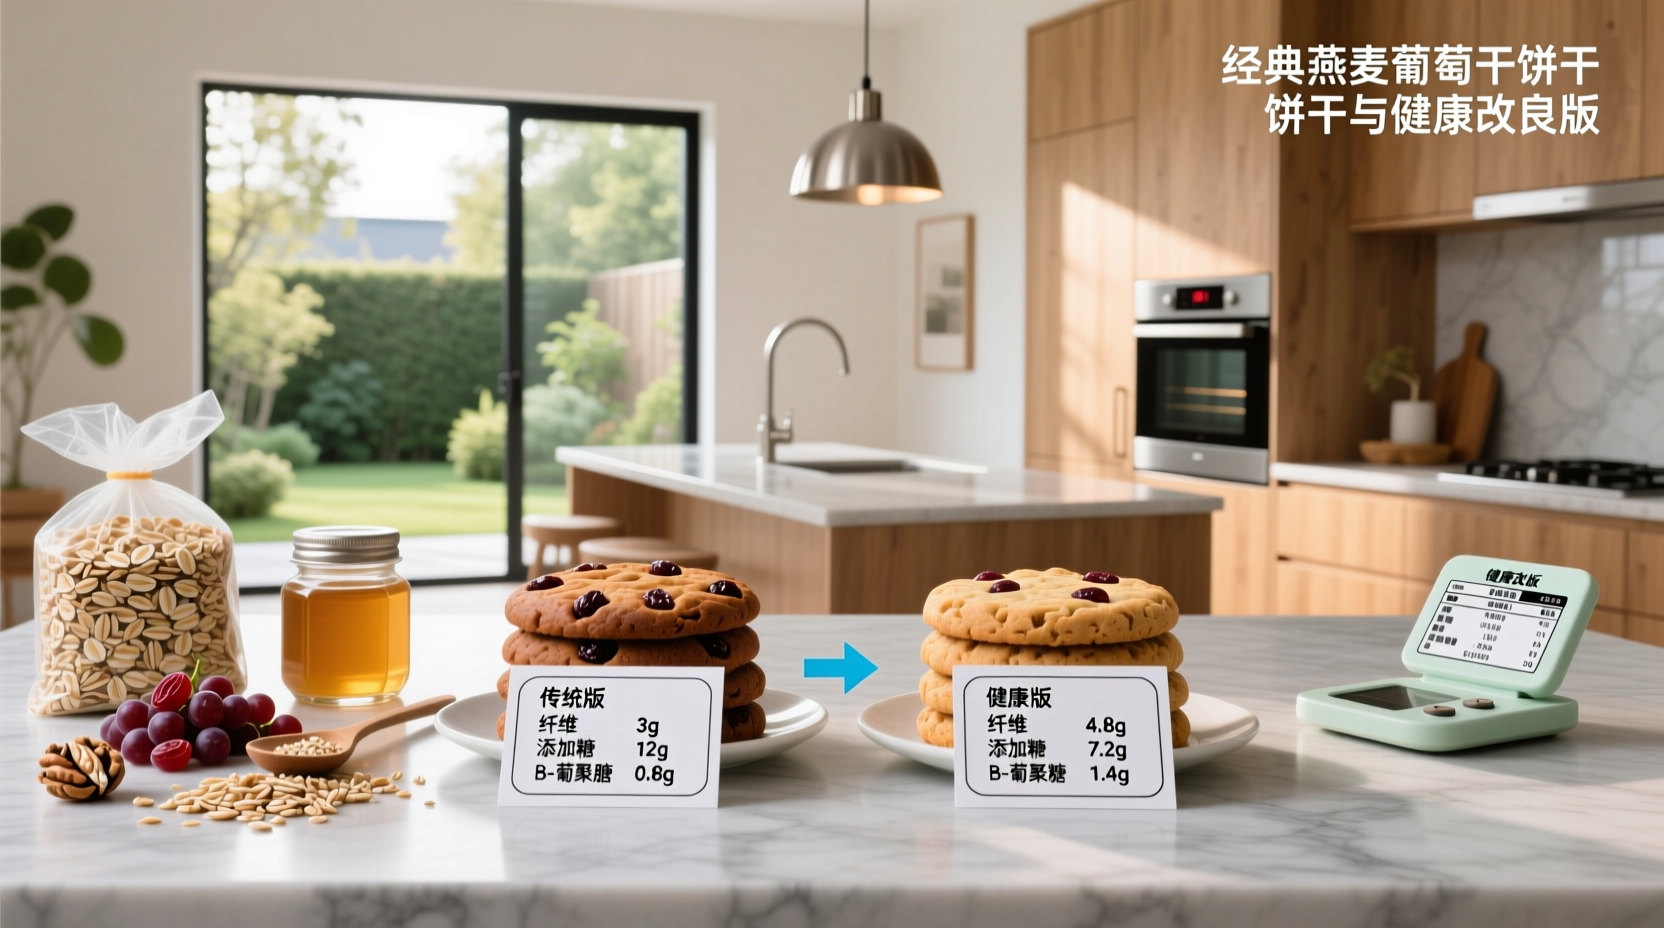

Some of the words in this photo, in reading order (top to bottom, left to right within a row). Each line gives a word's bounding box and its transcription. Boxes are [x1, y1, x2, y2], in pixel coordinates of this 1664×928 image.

[539, 687, 605, 708] 传统版
[986, 687, 1052, 708] 健康版
[538, 714, 578, 734] 纤维
[636, 717, 659, 737] 3g
[987, 714, 1028, 734] 纤维
[1086, 717, 1126, 737] 4.8g
[537, 738, 596, 758] 添加糖
[637, 741, 668, 761] 12g
[988, 738, 1046, 758] 添加糖
[1088, 741, 1127, 761] 7.2g
[634, 765, 674, 786] 0.8g
[1091, 766, 1129, 786] 1.4g
